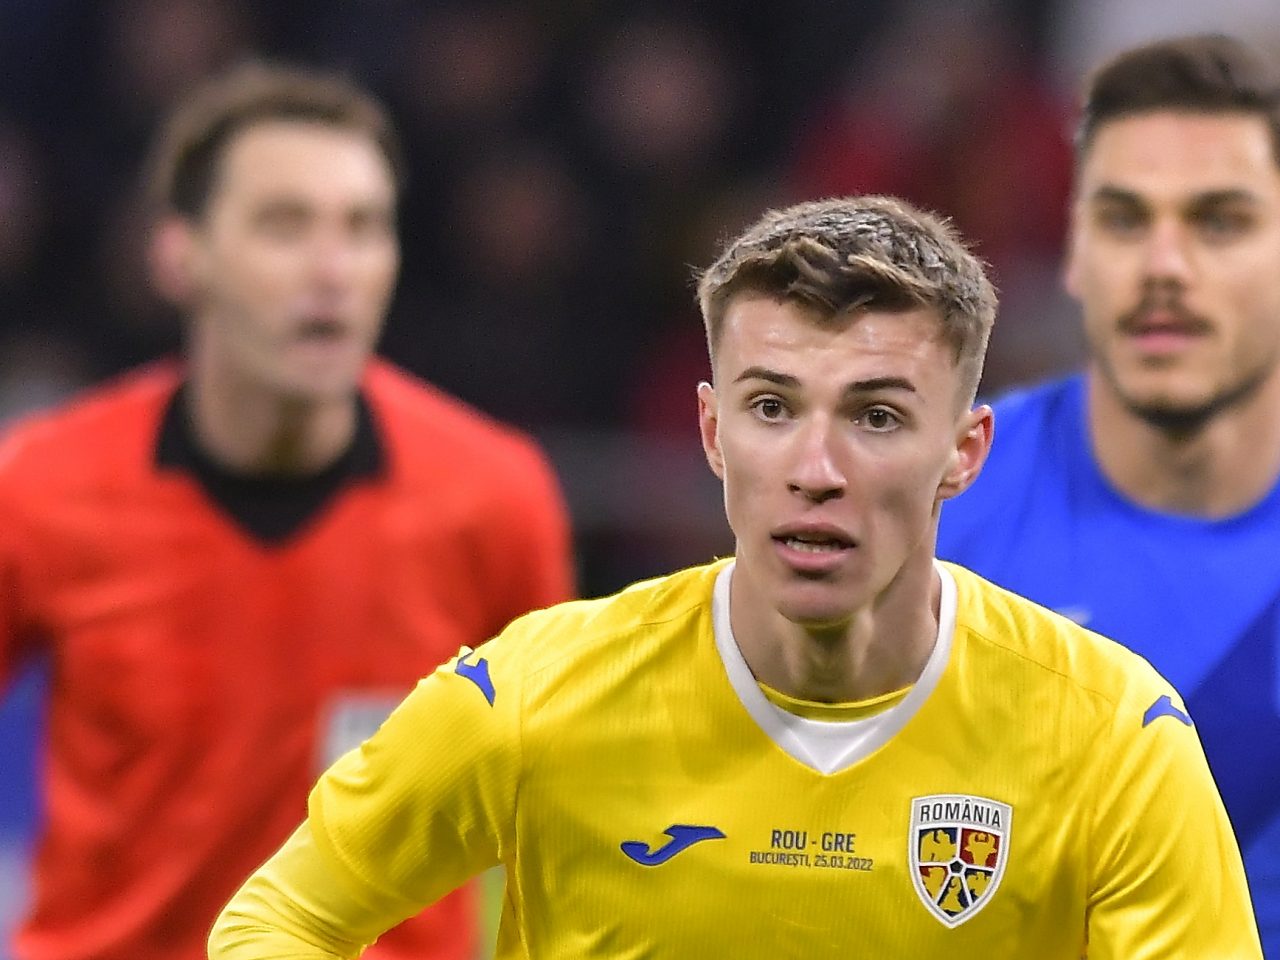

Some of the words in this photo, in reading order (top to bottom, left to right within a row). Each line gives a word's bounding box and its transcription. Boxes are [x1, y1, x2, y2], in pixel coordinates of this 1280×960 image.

[919, 799, 1001, 827] ROMÂNIA
[771, 829, 806, 850] ROU
[822, 833, 856, 854] GRE
[814, 855, 873, 871] 25.03.2022
